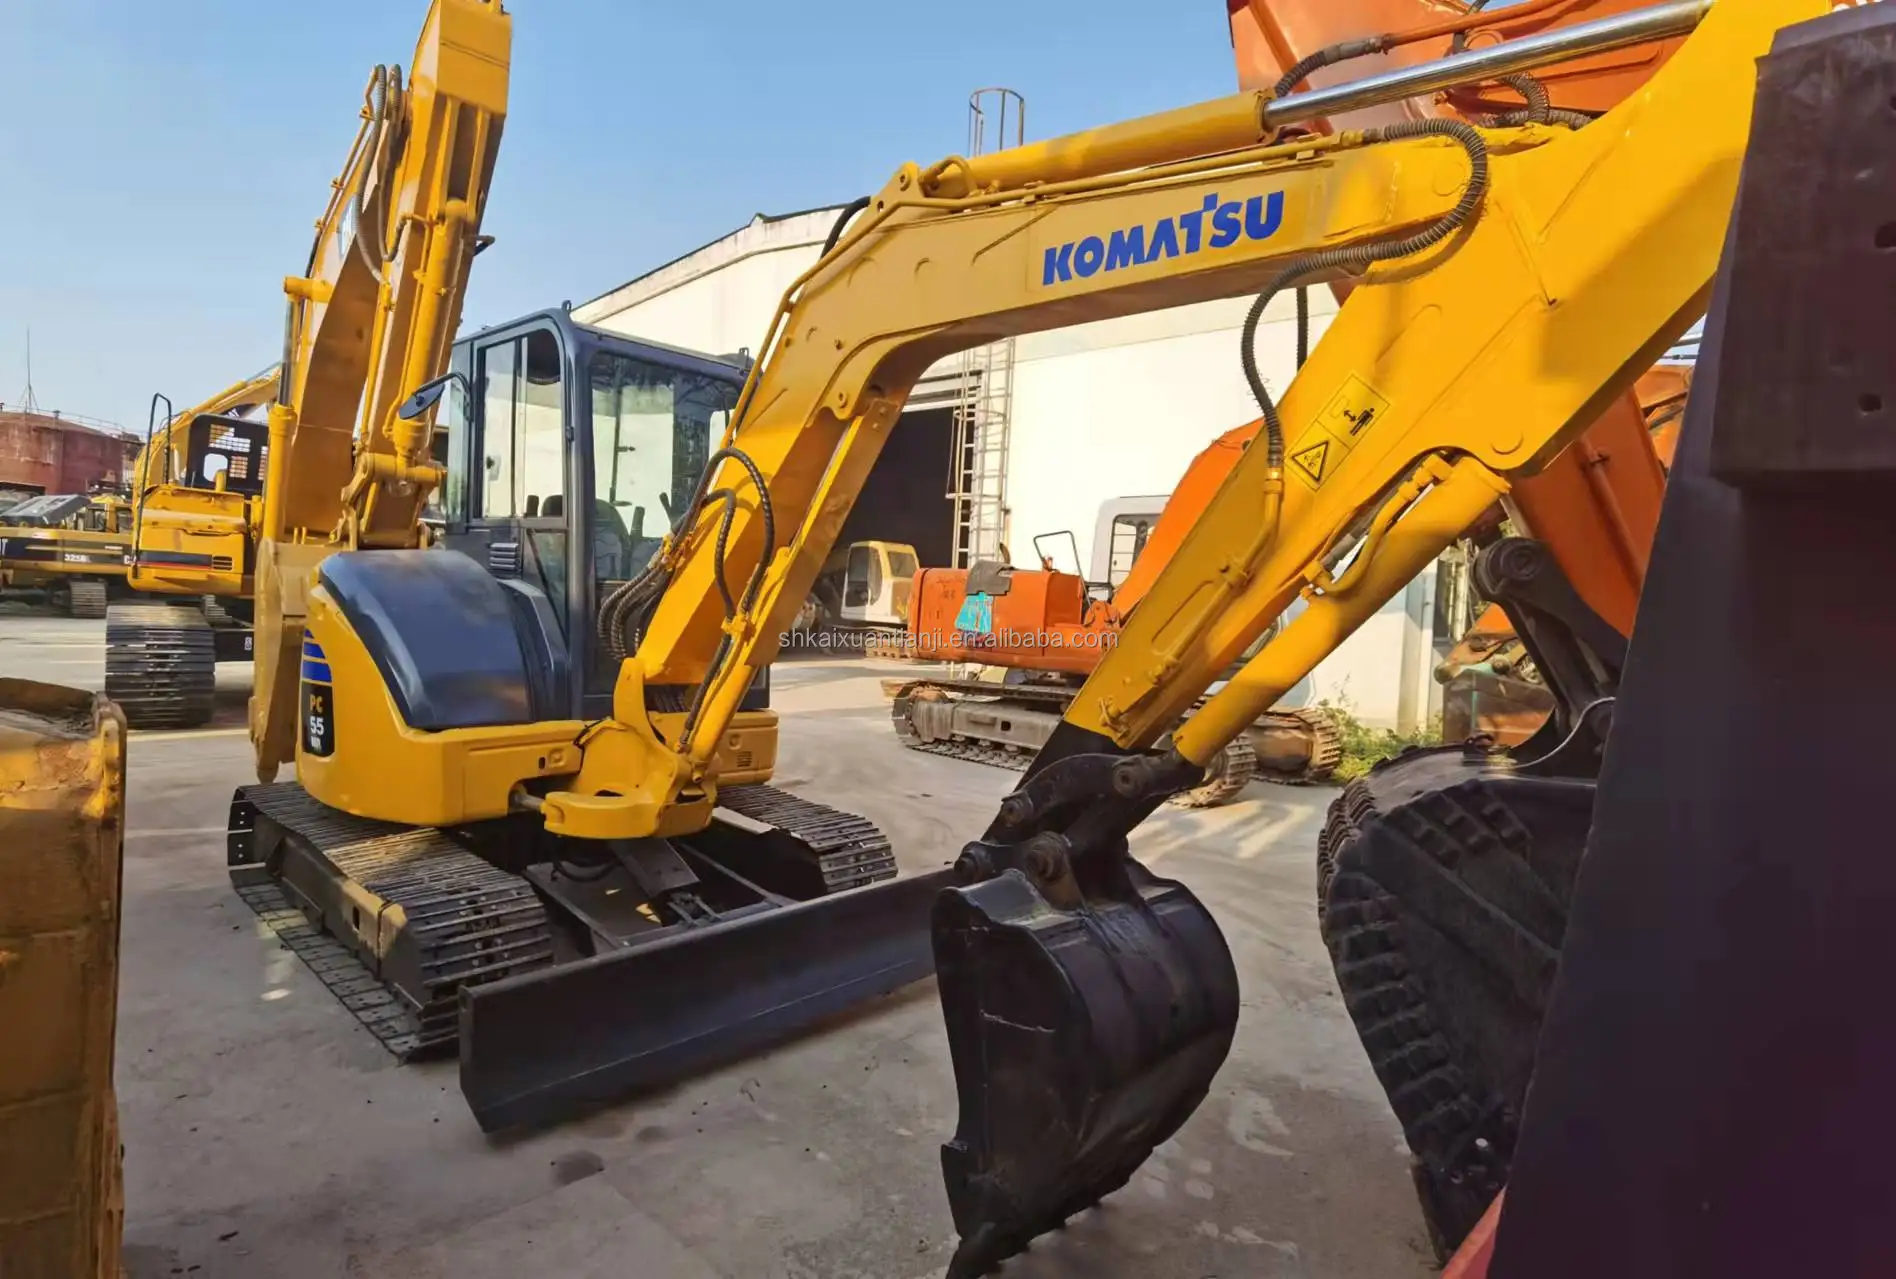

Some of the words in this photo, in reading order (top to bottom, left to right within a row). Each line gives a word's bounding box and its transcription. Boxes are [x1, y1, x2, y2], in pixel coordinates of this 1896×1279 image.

[1042, 190, 1285, 286] KOMATSU
[309, 694, 323, 713] PC
[309, 715, 325, 735] 55
